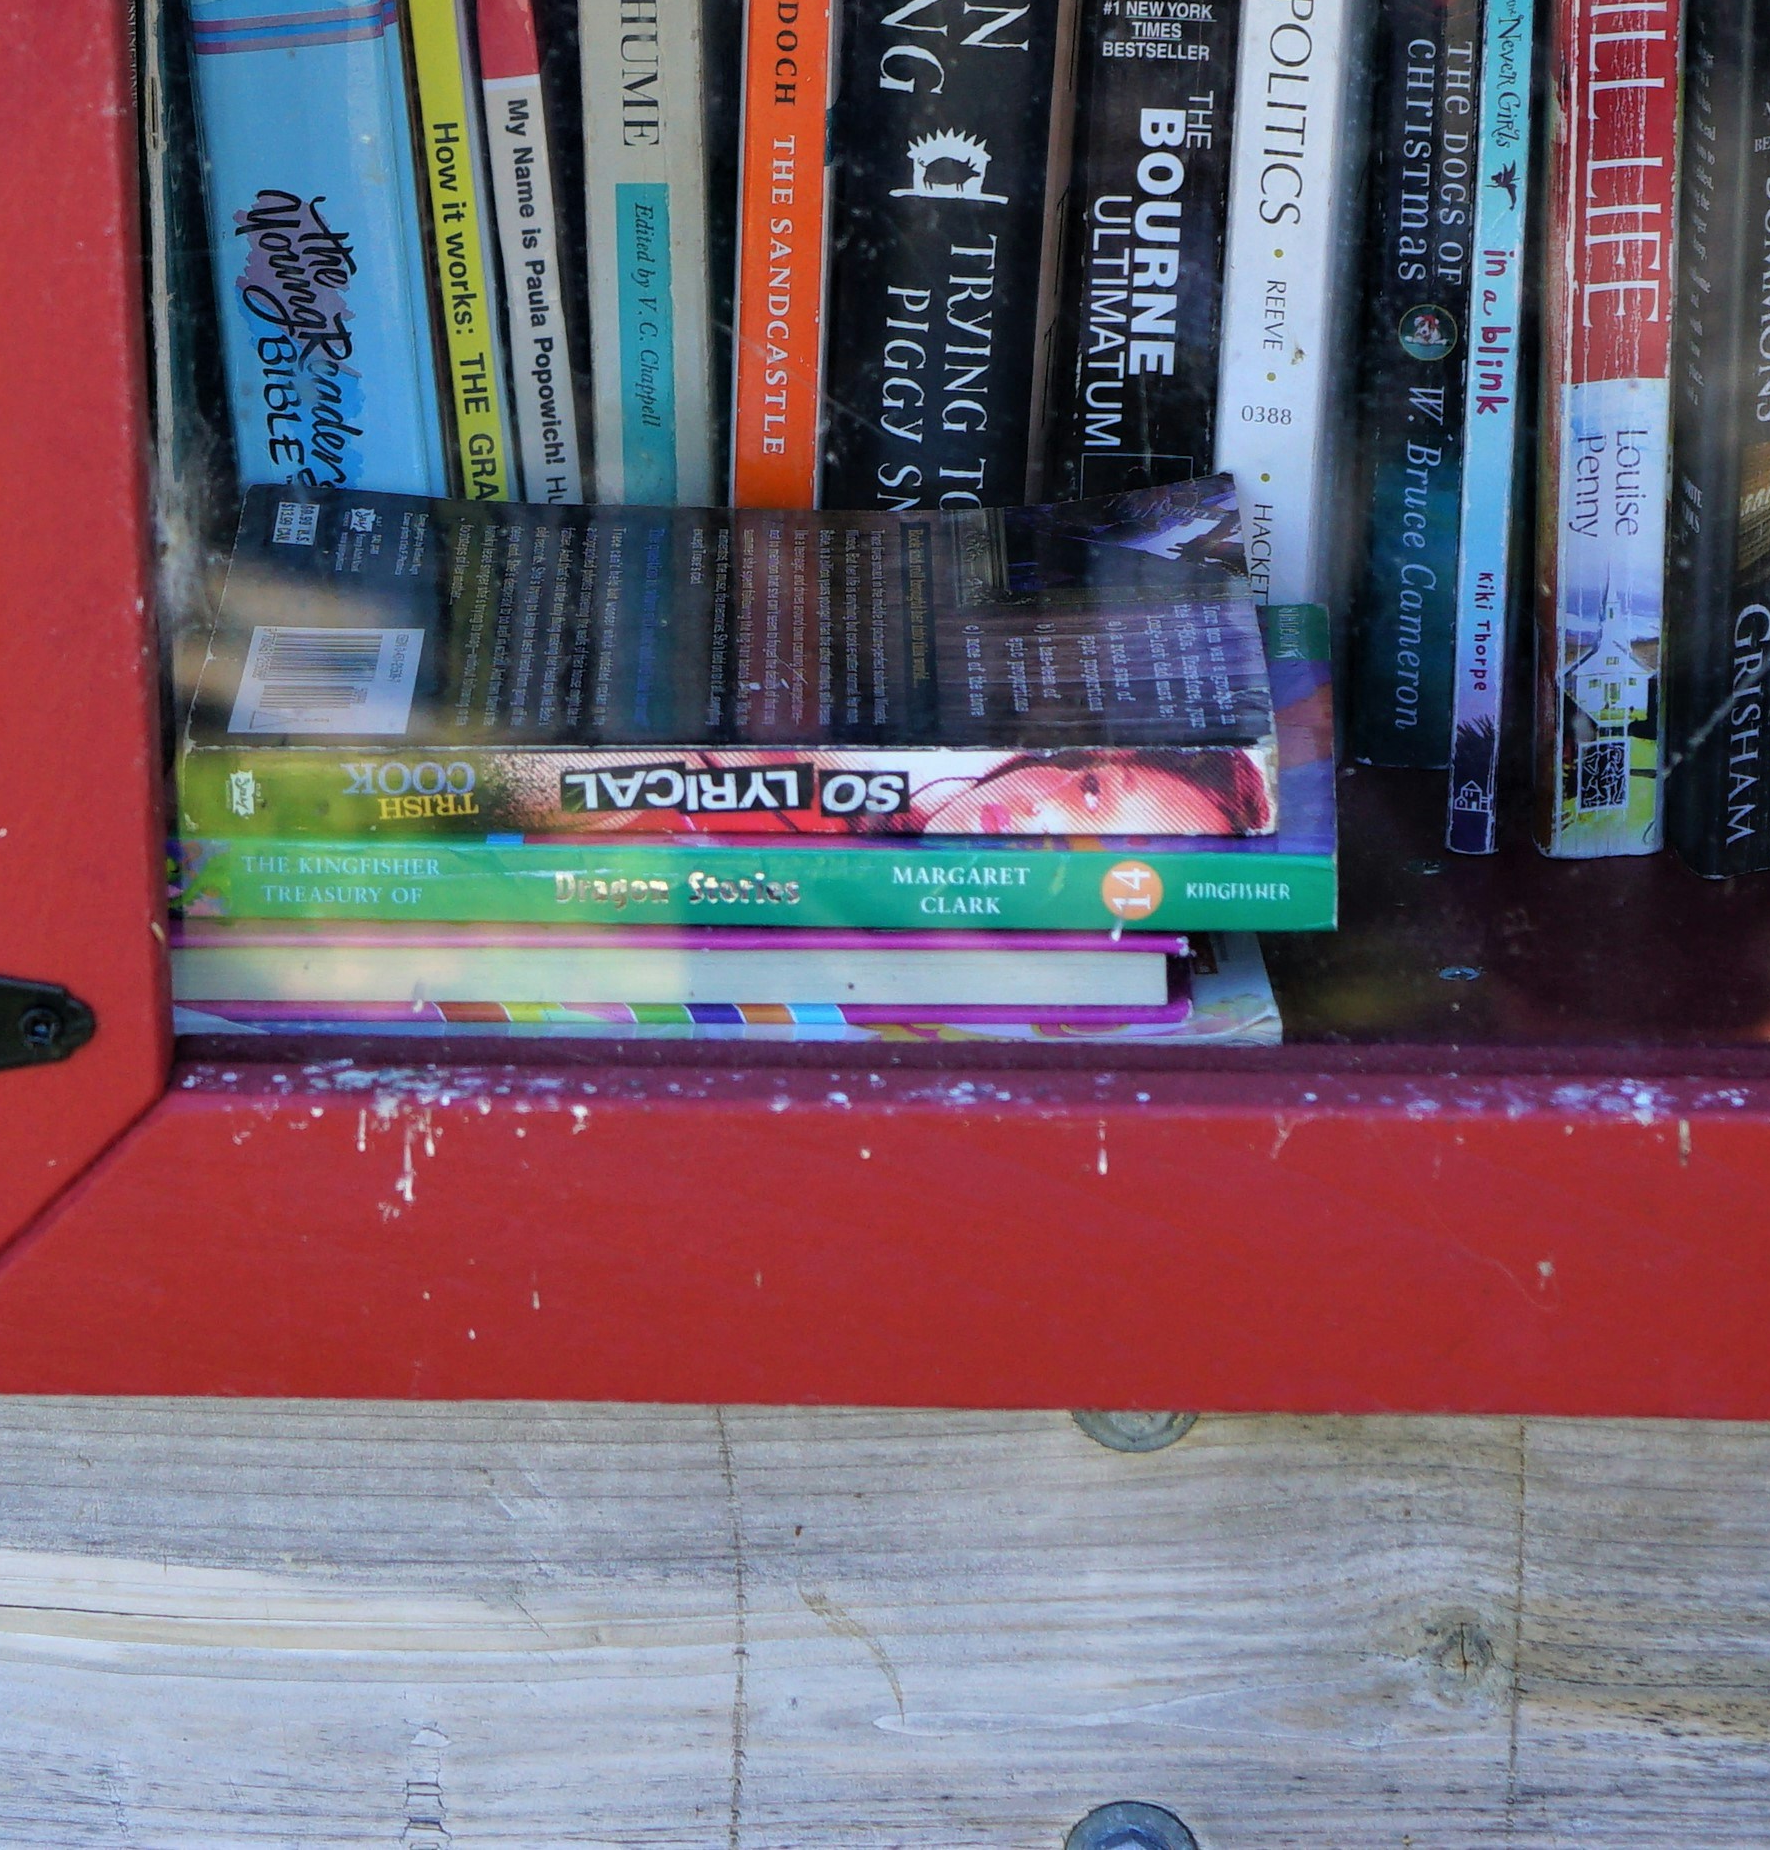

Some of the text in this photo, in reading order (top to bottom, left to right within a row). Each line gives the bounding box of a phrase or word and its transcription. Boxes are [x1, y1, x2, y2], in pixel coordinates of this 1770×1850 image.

[1102, 42, 1211, 60] BESTSELLER
[1104, 0, 1213, 19] #1 NEW YORK
[1132, 22, 1182, 39] TIMES
[1187, 91, 1214, 150] THE
[770, 134, 795, 205] THE
[1437, 130, 1471, 287] DOGS OF
[504, 99, 565, 464] My Name is Paula Popowich!
[1128, 107, 1186, 376] BOURNE
[1583, 156, 1664, 328] LIFE
[433, 122, 498, 500] How it works: THE GRA
[635, 203, 661, 427] Edited Chappell
[763, 218, 793, 455] SANDCASTLE
[942, 234, 999, 432] TRYING
[1083, 195, 1133, 447] ULTIMATUM
[1262, 280, 1287, 351] REEVE
[1477, 249, 1515, 416] in a blink
[258, 334, 305, 466] BIBLE
[881, 285, 931, 443] PIGGY
[1241, 405, 1293, 426] 0388
[1568, 433, 1606, 538] Penny
[1614, 429, 1648, 536] Louise
[1395, 386, 1446, 730] W. Bruce Cameron
[1473, 572, 1495, 692] Kiki Thorpe
[341, 761, 476, 796] COOK
[378, 793, 479, 820] TRISH
[565, 768, 906, 813] SO LYRICAL
[241, 856, 440, 876] THE KINGFISHER
[262, 885, 423, 904] TREASURY OF
[554, 871, 801, 911] Dragon Stories
[892, 866, 1031, 887] MARGARET
[920, 896, 1002, 916] CLARK
[1186, 882, 1291, 901] KINGFISHER
